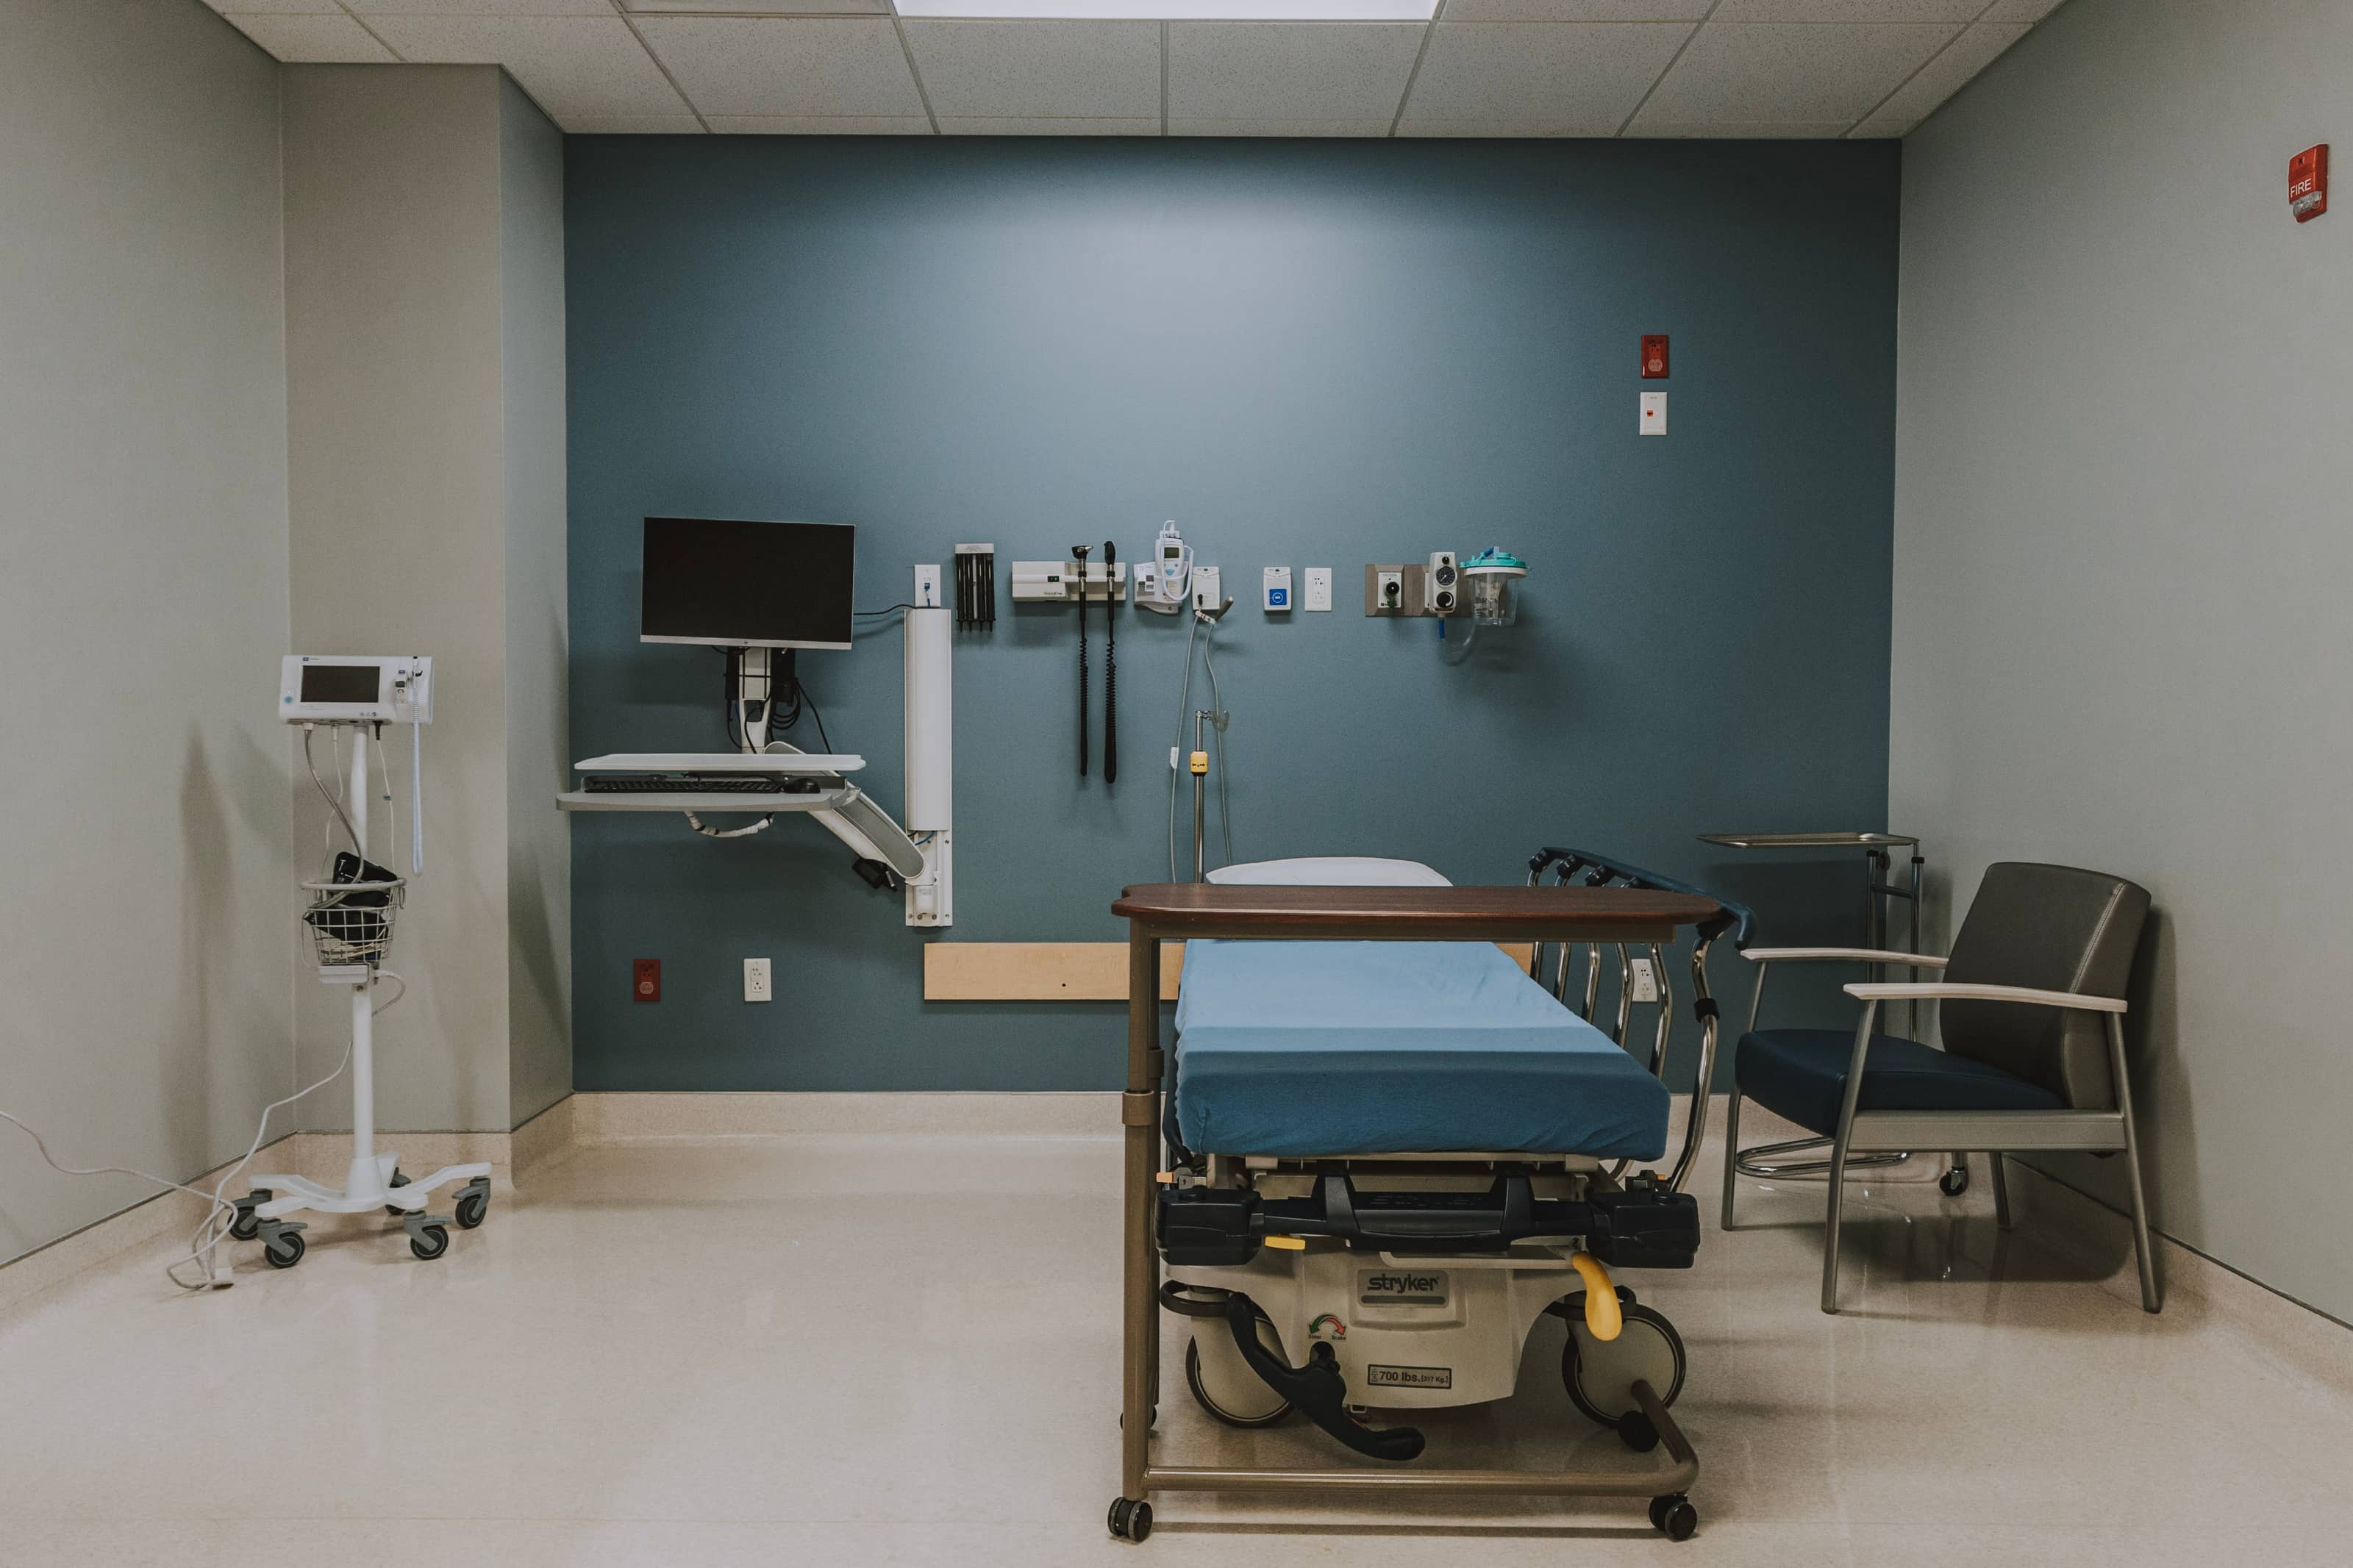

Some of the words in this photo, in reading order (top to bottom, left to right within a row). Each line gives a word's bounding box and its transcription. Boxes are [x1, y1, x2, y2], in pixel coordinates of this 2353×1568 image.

[2290, 178, 2312, 198] FIRE
[1367, 1273, 1439, 1294] stryker
[1379, 1371, 1399, 1381] 700
[1402, 1372, 1421, 1382] lbs.
